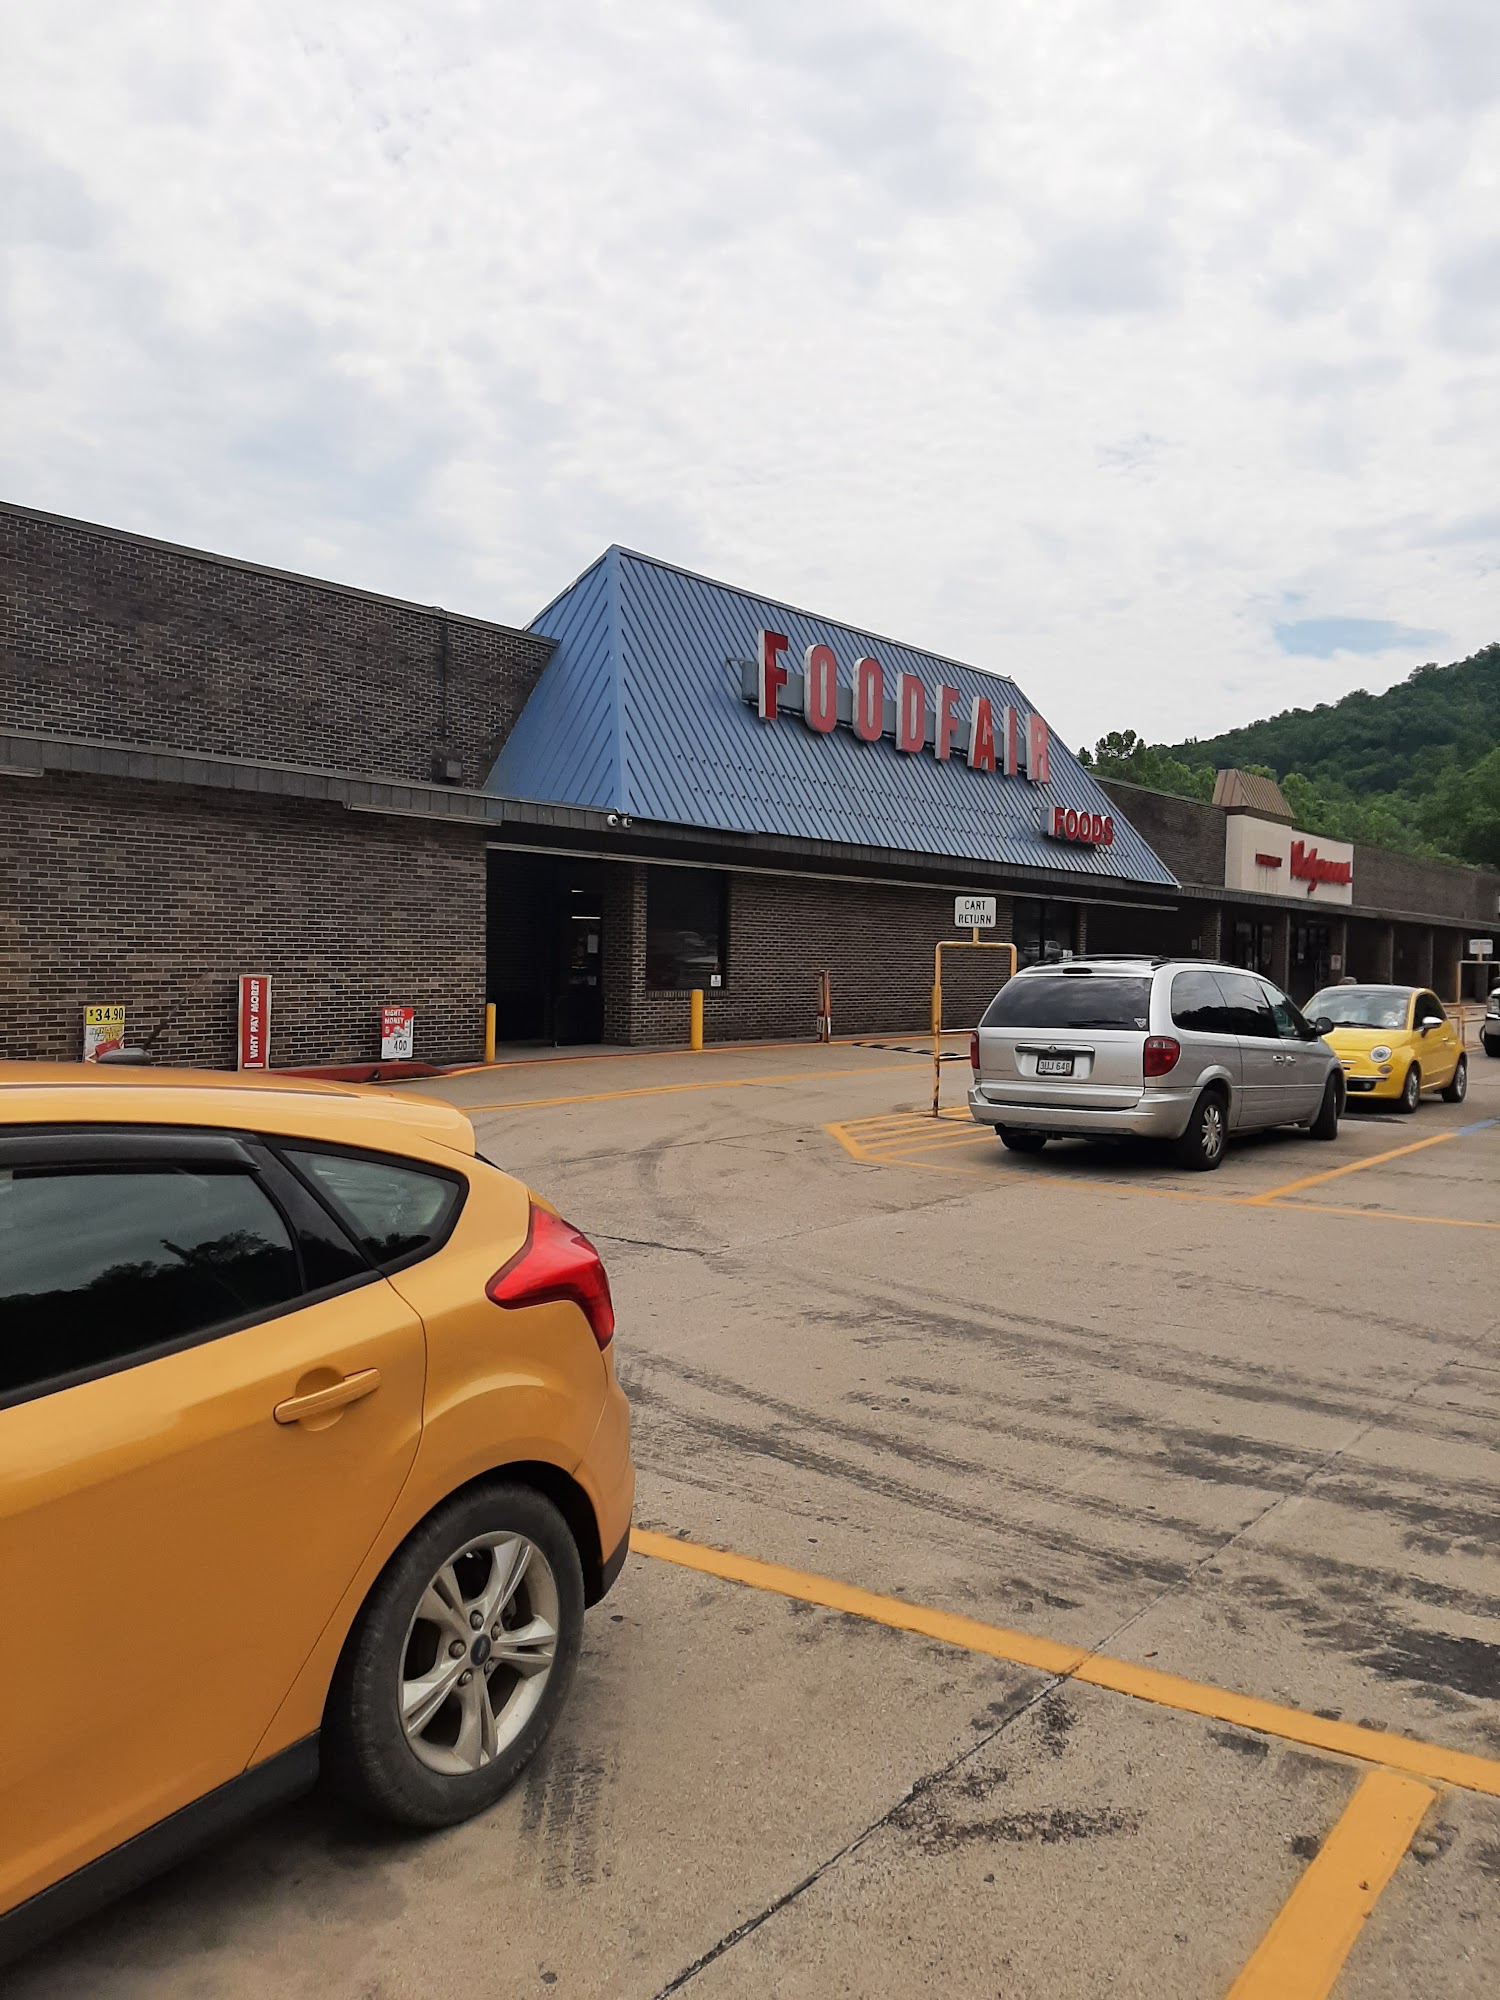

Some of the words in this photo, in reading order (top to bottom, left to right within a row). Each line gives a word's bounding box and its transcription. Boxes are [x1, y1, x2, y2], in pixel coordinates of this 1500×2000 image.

[1048, 806, 1114, 846] FOODS
[964, 900, 986, 911] CART
[958, 913, 992, 925] RETURN
[250, 1014, 259, 1033] PAY
[249, 1035, 259, 1059] WHY
